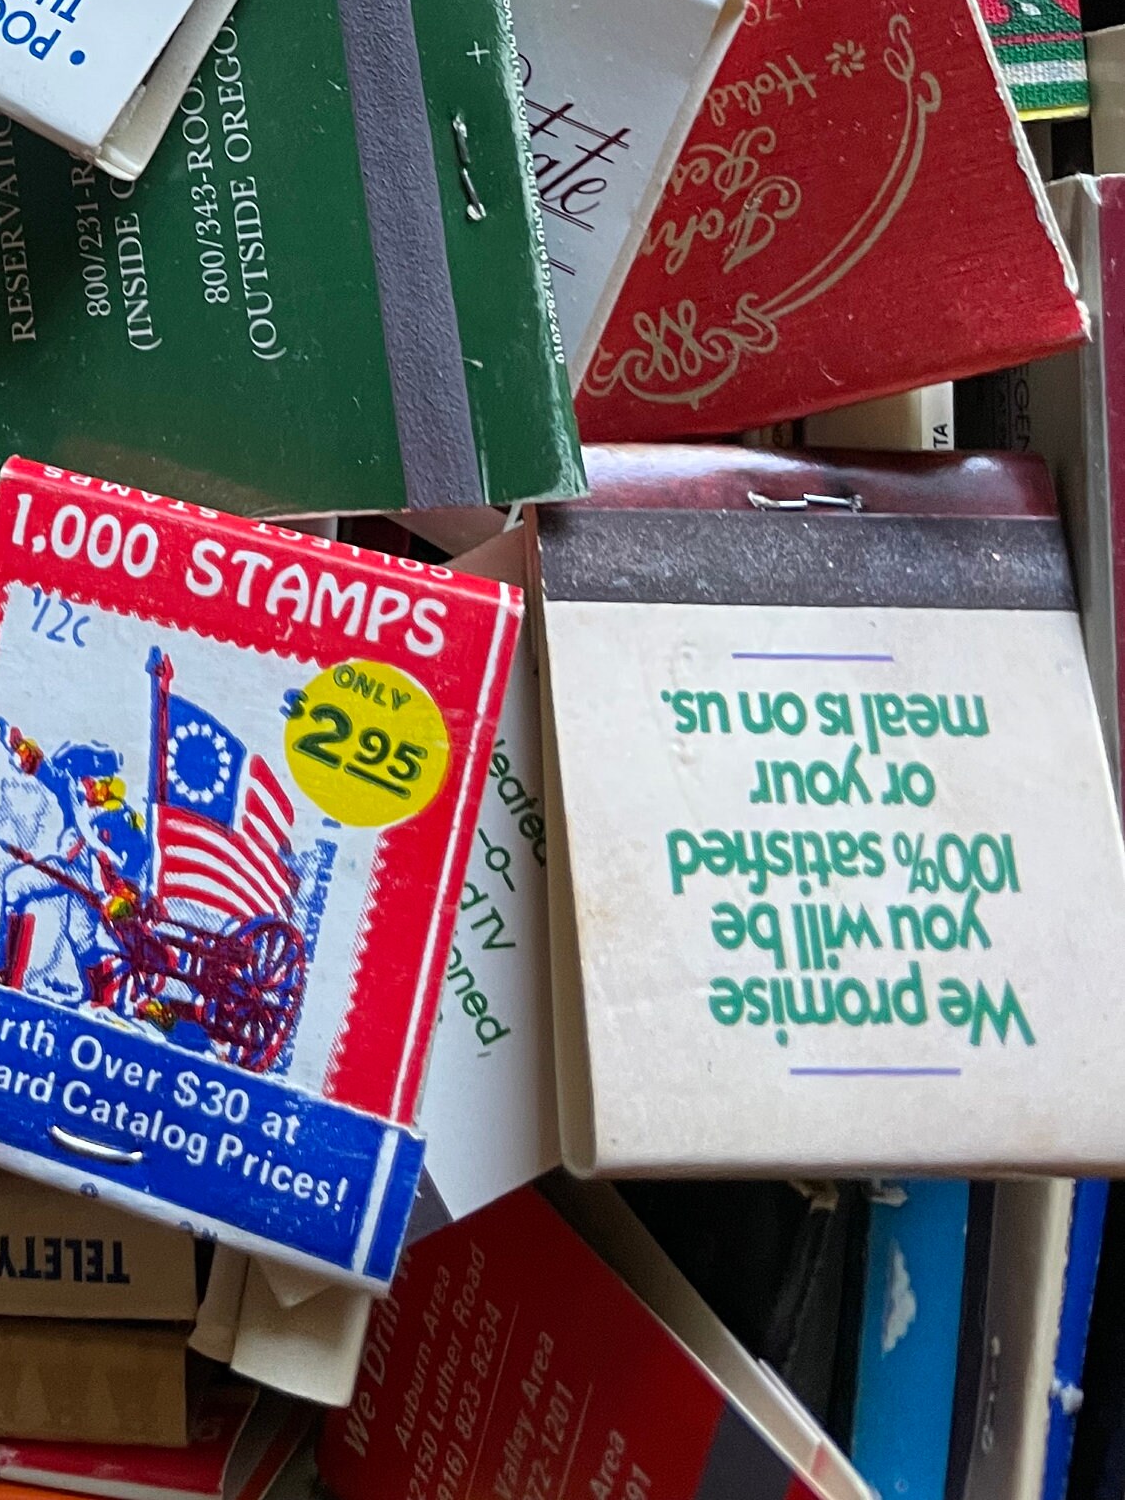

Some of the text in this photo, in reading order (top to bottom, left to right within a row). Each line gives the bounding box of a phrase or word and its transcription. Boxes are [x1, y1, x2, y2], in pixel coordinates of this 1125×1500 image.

[171, 73, 235, 306] 800/343-ROO
[205, 11, 289, 362] (OUTSIDE OREGO
[111, 210, 163, 352] (INSIDE
[3, 490, 457, 662] 1,000 STAMPS
[327, 660, 416, 715] ONLY
[658, 686, 992, 757] meal is on us.
[746, 741, 938, 813] or your
[664, 818, 1020, 904] 100% satisfied
[463, 903, 526, 971] TV
[709, 885, 992, 974] you will be
[705, 960, 1036, 1052] We promise
[63, 1030, 169, 1096] Over
[167, 1066, 256, 1129] $30
[257, 1111, 305, 1149] at
[53, 1077, 215, 1167] Catalog
[209, 1130, 355, 1214] Prices!
[375, 1259, 467, 1453] Auburn Area
[505, 1325, 572, 1411] Area
[331, 1385, 393, 1460] We
